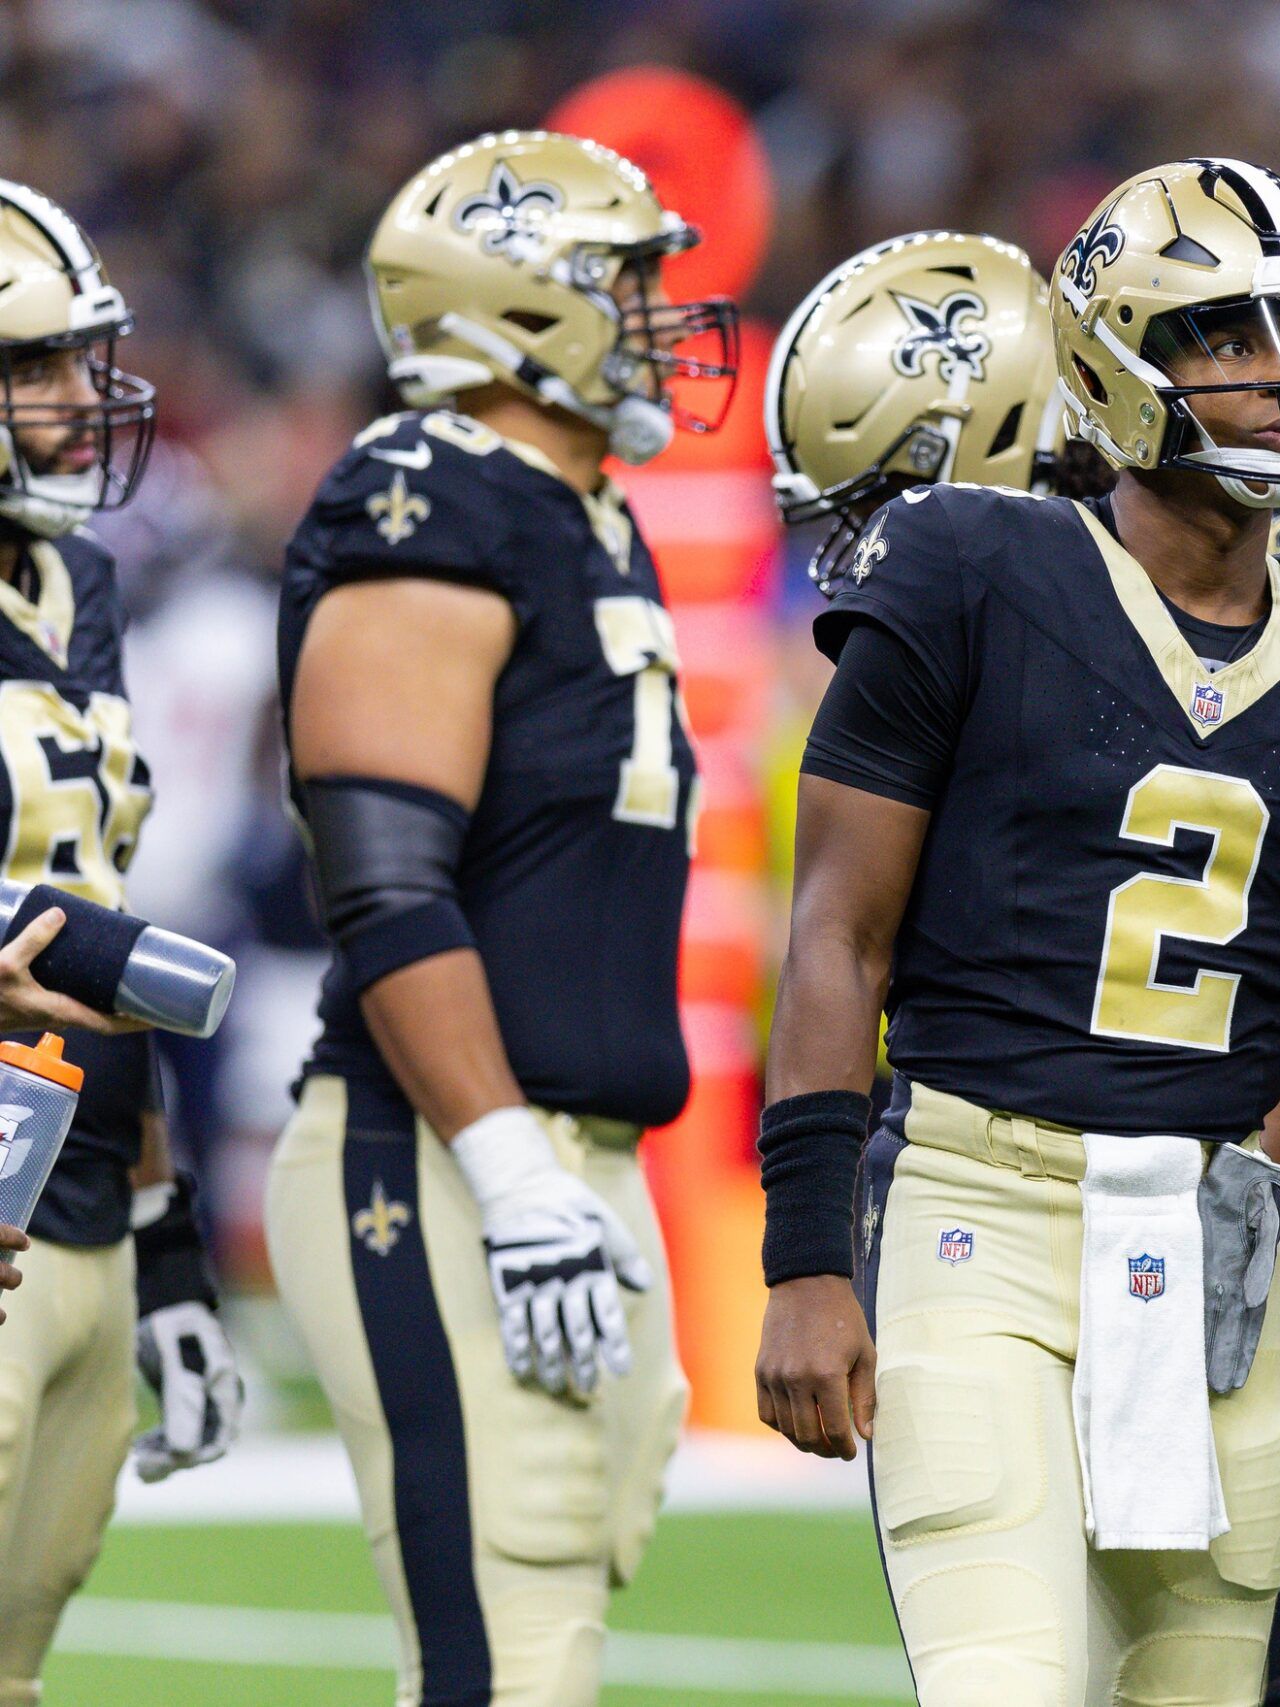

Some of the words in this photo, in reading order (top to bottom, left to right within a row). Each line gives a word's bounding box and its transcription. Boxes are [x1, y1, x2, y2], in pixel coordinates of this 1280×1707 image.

[1195, 699, 1220, 719] NFL
[592, 595, 703, 862] 7
[1090, 763, 1270, 1053] 2
[942, 1242, 969, 1259] NFL
[1132, 1273, 1162, 1297] NFL
